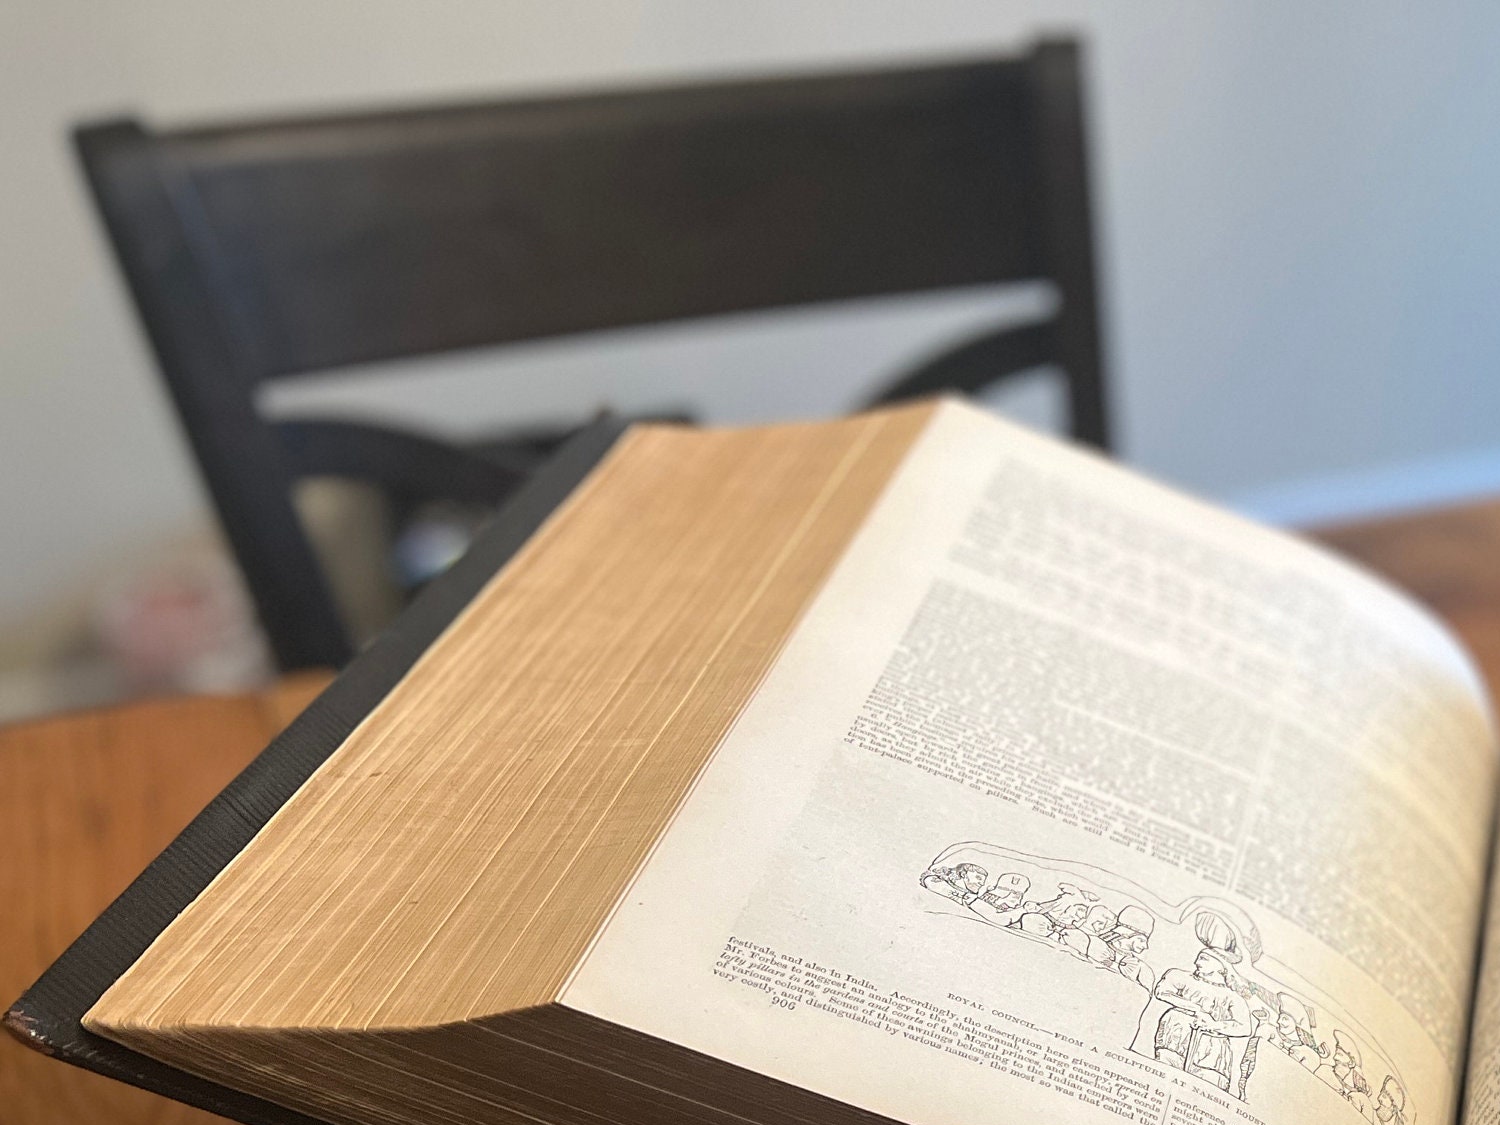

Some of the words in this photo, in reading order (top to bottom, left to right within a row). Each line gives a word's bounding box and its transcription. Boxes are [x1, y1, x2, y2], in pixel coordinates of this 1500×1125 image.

[843, 737, 856, 746] of
[916, 762, 965, 786] supported
[969, 783, 982, 792] on
[985, 788, 1020, 806] pillars.
[1031, 804, 1057, 820] Such
[1062, 817, 1079, 828] are
[1083, 824, 1104, 837] still
[713, 970, 736, 984] very
[741, 978, 776, 996] costly,
[780, 991, 802, 1002] and
[805, 997, 881, 1028] distinguished
[885, 1023, 899, 1037] by
[903, 1031, 942, 1049] various
[989, 1060, 1008, 1072] the
[1010, 1069, 1035, 1082] most
[1039, 1080, 1051, 1088] so
[1055, 1086, 1075, 1097] was
[1078, 1093, 1100, 1107] that
[1103, 1104, 1134, 1120] called
[728, 935, 777, 959] festivals,
[780, 954, 803, 966] and
[805, 962, 827, 974] also
[830, 969, 841, 978] in
[846, 975, 878, 991] India.
[890, 990, 959, 1022] Accordingly,
[963, 1016, 981, 1028] the
[984, 1023, 1042, 1050] description
[1046, 1046, 1069, 1060] here
[1072, 1057, 1101, 1072] given
[1105, 1070, 1150, 1091] appeared
[1155, 1088, 1165, 1098] to
[772, 996, 797, 1012] 906
[947, 993, 984, 1011] ROYAL
[1104, 1051, 1166, 1079] SCULPTURE
[1171, 1078, 1186, 1088] AT
[1175, 1098, 1225, 1125] conference
